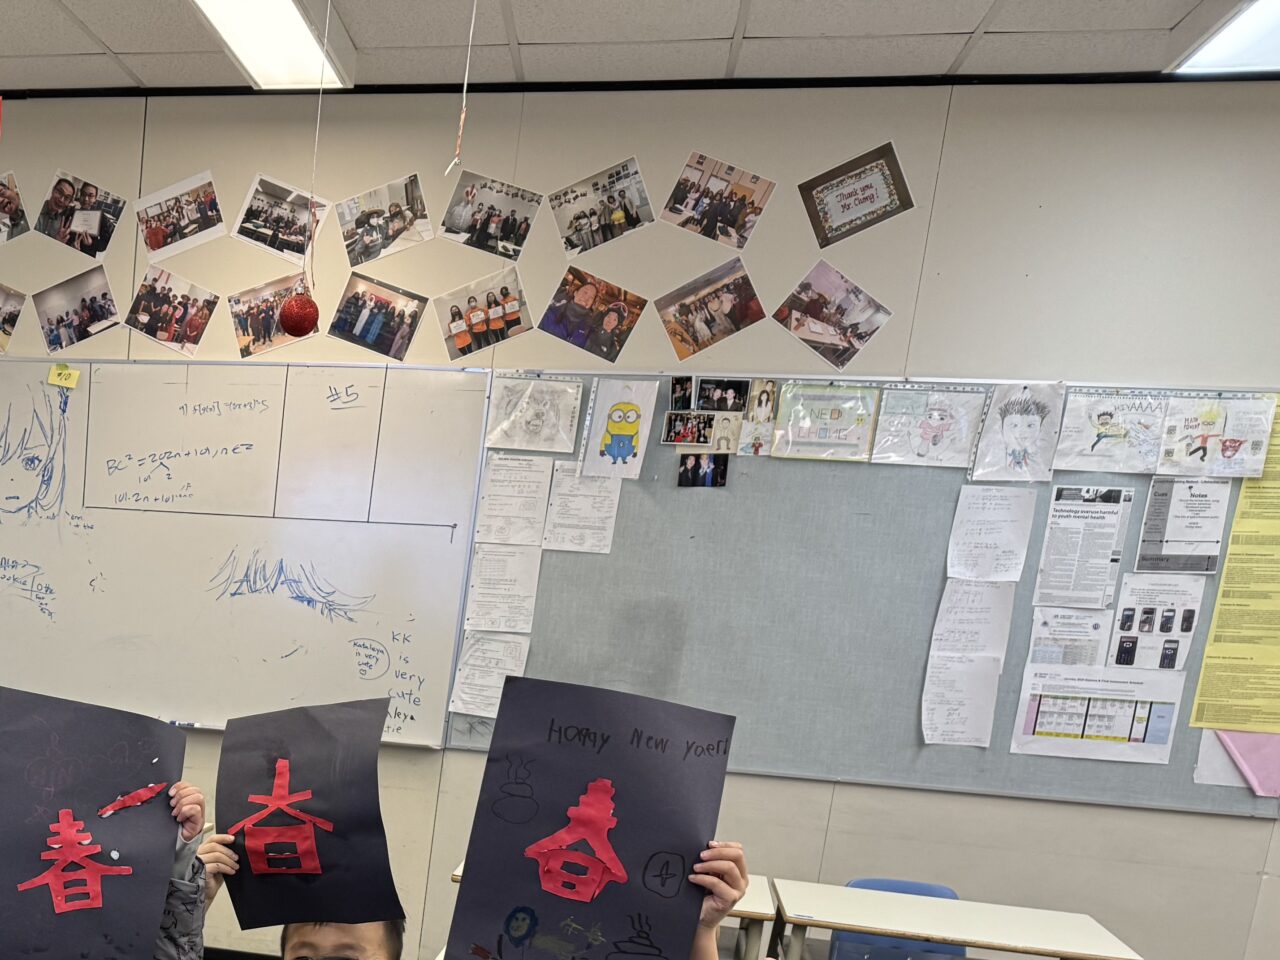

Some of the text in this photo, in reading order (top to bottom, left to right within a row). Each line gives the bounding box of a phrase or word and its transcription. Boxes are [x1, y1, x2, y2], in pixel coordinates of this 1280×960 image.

[836, 182, 874, 203] Thank you
[326, 384, 360, 405] #5
[392, 630, 412, 644] KK
[358, 661, 373, 669] cute
[365, 653, 379, 665] very
[399, 655, 410, 664] is
[394, 670, 425, 691] very
[630, 728, 670, 753] New
[17, 808, 133, 914] 春
